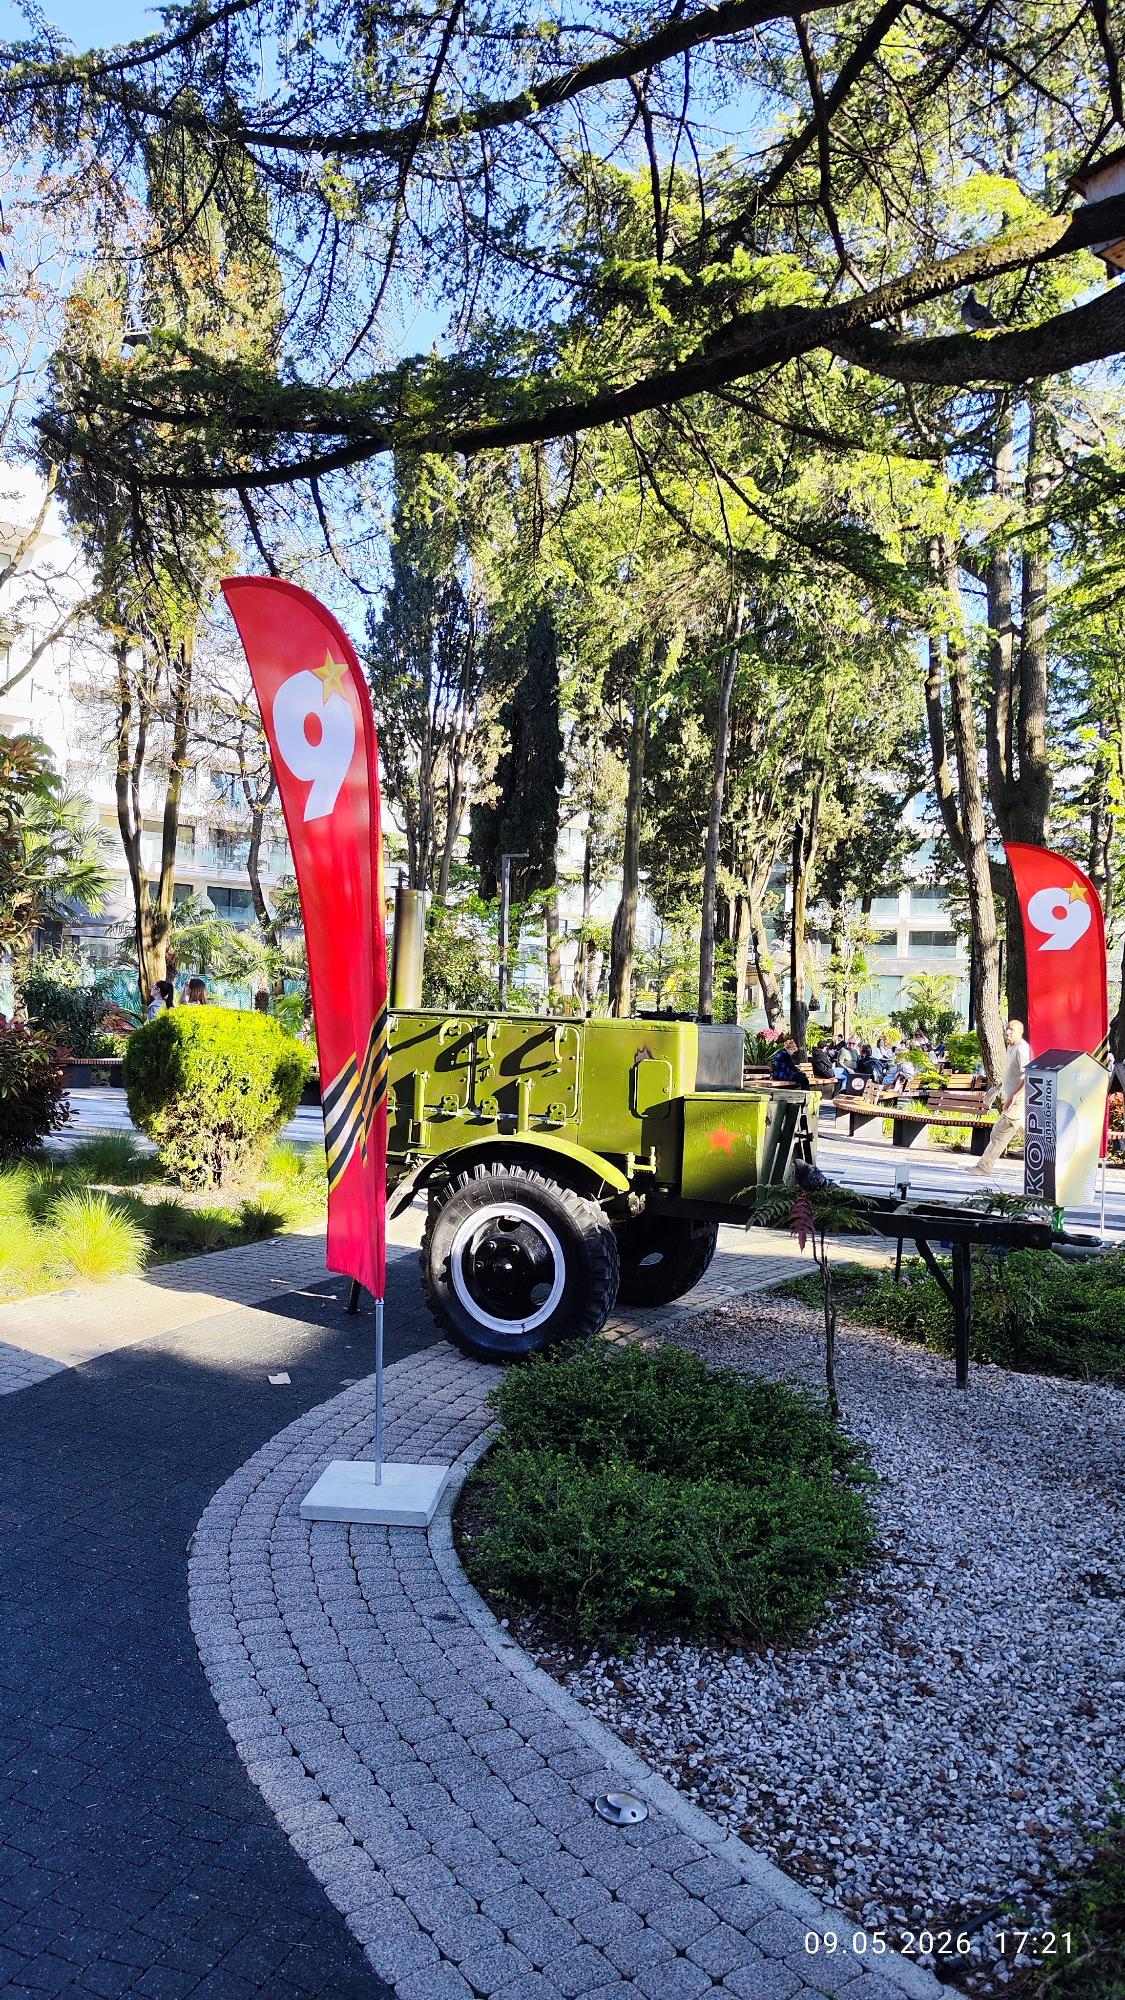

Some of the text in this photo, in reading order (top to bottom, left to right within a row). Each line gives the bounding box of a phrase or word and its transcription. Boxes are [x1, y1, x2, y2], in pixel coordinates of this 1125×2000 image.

[272, 669, 356, 823] 9
[1027, 887, 1092, 952] 9
[1026, 1075, 1045, 1198] КОРМ
[1044, 1079, 1053, 1145] для белок
